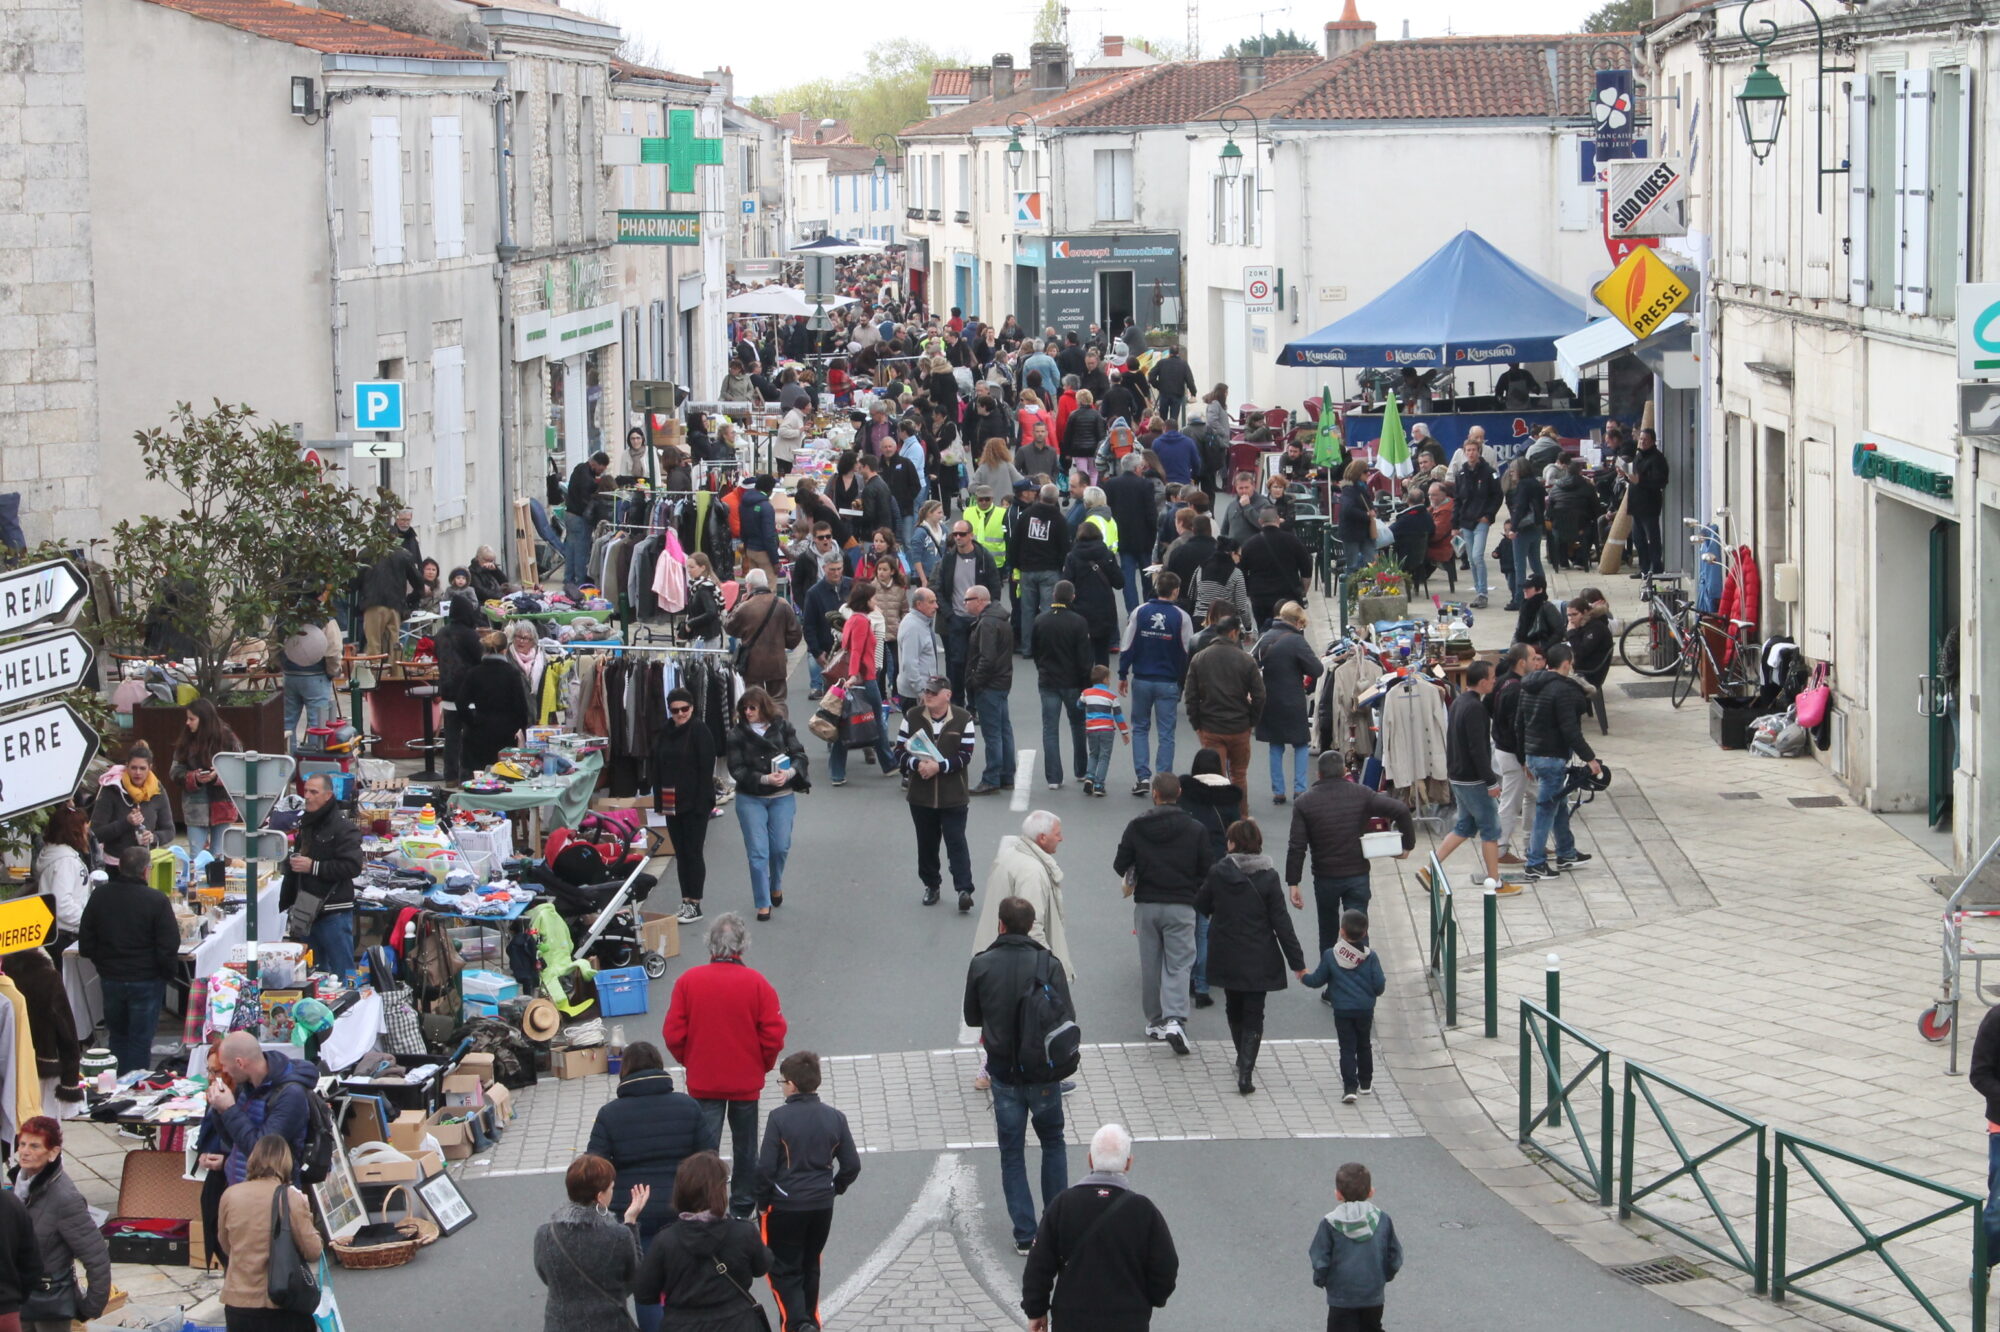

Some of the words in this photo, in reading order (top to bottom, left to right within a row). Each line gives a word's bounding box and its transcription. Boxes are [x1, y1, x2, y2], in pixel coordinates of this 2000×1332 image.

[1612, 198, 1642, 229] SUD
[1634, 162, 1676, 205] OUEST
[620, 217, 697, 238] PHARMACIE
[1113, 246, 1175, 257] Immobilier
[1253, 285, 1265, 294] 30
[1633, 284, 1682, 333] PRESSE
[367, 388, 389, 421] P
[0, 923, 42, 948] IERRES
[1338, 946, 1356, 962] GIVE
